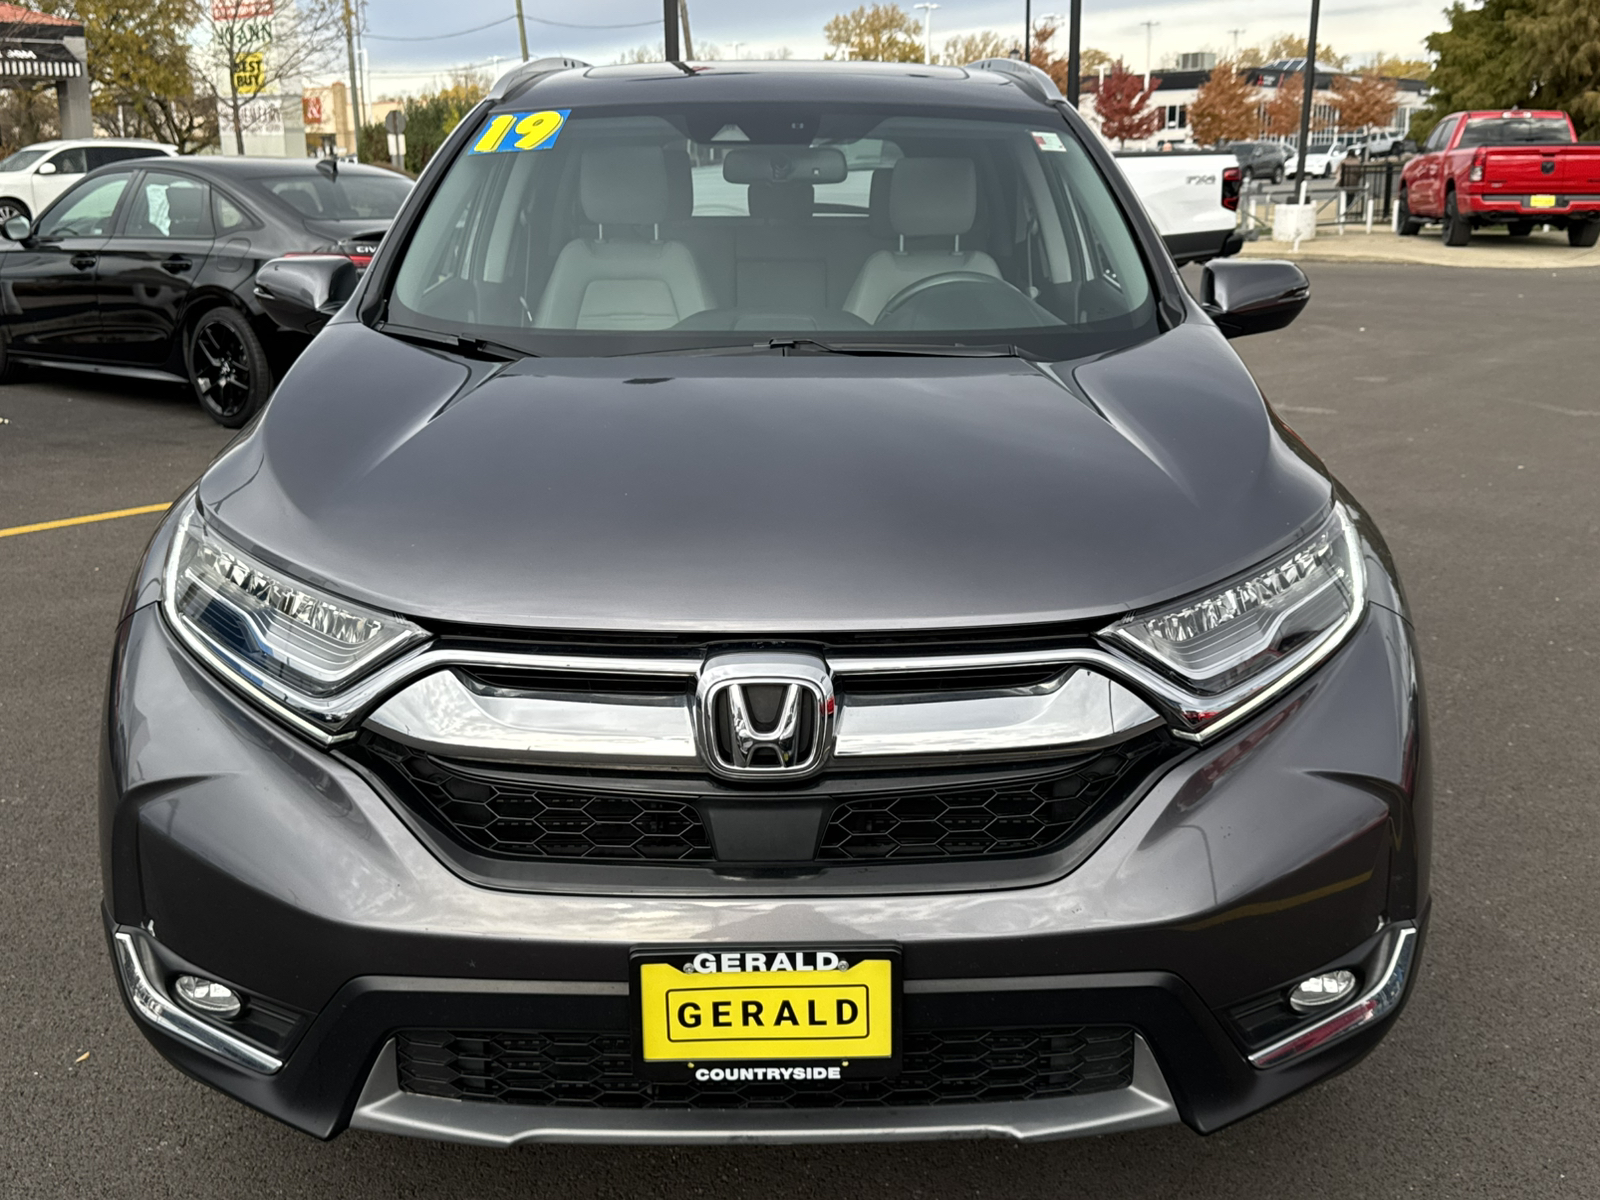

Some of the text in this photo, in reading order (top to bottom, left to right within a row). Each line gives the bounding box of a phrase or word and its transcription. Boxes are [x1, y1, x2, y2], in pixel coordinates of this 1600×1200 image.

[236, 74, 260, 87] BUY
[474, 110, 564, 152] 19
[356, 245, 377, 253] CIV
[693, 951, 840, 974] GERALD
[677, 998, 859, 1029] GERALD
[695, 1066, 841, 1082] COUNTRYSIDE
